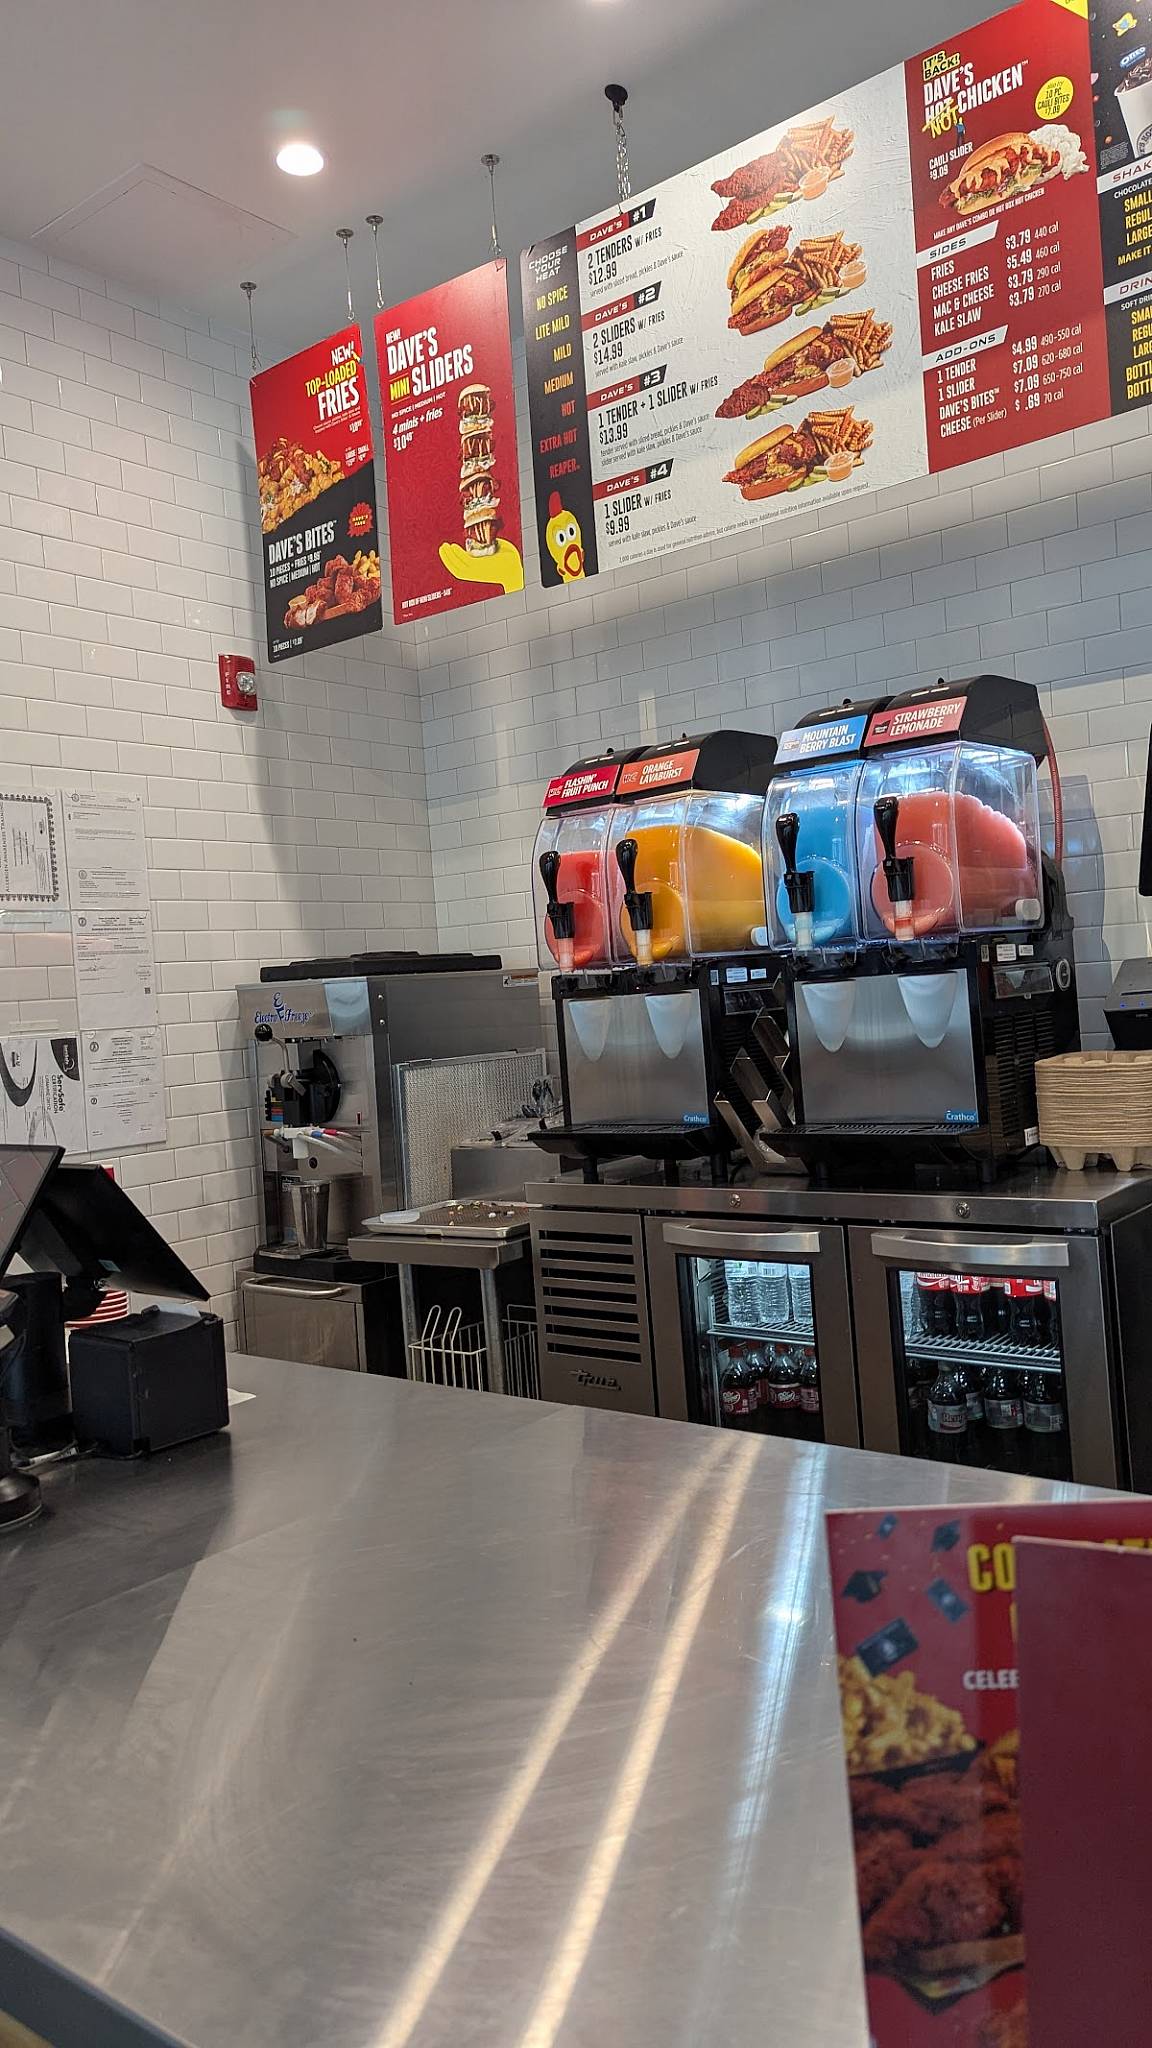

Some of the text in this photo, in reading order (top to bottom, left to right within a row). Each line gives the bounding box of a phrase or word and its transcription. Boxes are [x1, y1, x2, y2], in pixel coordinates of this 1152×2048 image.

[924, 52, 945, 69] IT'S
[925, 55, 960, 80] BACK!
[923, 62, 974, 106] DAVE'S
[929, 142, 973, 170] CAULI SLIDER
[929, 164, 949, 181] $9.09
[590, 205, 648, 242] DAVE'S #1
[529, 245, 568, 270] CHOOSE
[587, 253, 594, 269] 2
[594, 235, 633, 266] TENDERS
[645, 227, 663, 244] FRIES
[929, 237, 967, 259] SIDES
[931, 220, 1059, 282] FRIES $3.79 440 cal
[1117, 244, 1152, 266] MAKE IT
[534, 257, 562, 276] YOUR
[535, 265, 561, 284] HEAT
[588, 261, 617, 286] $12.99
[931, 241, 1060, 300] CHEESE FRIES $5.49 460 cal
[536, 284, 569, 312] NO SPICE
[933, 261, 1061, 320] MAC & CHEESE $3.79 290 cal
[595, 287, 656, 322] DAVE'S #2
[934, 280, 1062, 337] KALE SLAW $3.79 270 cal
[1121, 299, 1138, 311] SOFT
[386, 327, 402, 345] NEW!
[535, 314, 570, 341] LITE MILD
[592, 332, 599, 349] 2
[601, 316, 636, 346] SLIDERS
[648, 310, 665, 327] FRIES
[331, 341, 355, 367] NEW!
[387, 325, 439, 376] DAVE'S
[554, 342, 572, 363] MILD
[593, 341, 623, 366] $14.99
[935, 333, 996, 363] ADD-ONS
[937, 322, 1082, 384] 1 TENDER $4.99 490-550 cal
[305, 360, 358, 398] TOP-LOADED
[390, 344, 474, 402] MINI SLIDERS
[543, 370, 575, 395] MEDIUM
[938, 342, 1083, 402] 1 SLIDER $7.09 620-680 cal
[318, 377, 360, 421] FRIES
[600, 370, 661, 402] DAVE'S #3
[938, 400, 969, 421] DAVE'S
[1014, 373, 1040, 394] $7.09
[1042, 365, 1072, 386] 650-750
[1072, 363, 1083, 377] cal
[561, 399, 576, 417] HOT
[598, 412, 605, 429] 1
[606, 400, 639, 426] TENDER
[648, 393, 655, 411] 1
[657, 381, 688, 408] SLIDER
[701, 375, 719, 391] FRIES
[940, 416, 972, 438] CHEESE
[972, 414, 986, 429] (Per
[987, 407, 1007, 424] Slider)
[1043, 391, 1053, 404] 70
[1053, 388, 1064, 401] cal
[392, 407, 444, 436] 4 minis + fries
[599, 422, 628, 446] $13.99
[539, 427, 578, 455] EXTRA HOT
[606, 463, 668, 493] DAVE'S #4
[604, 503, 611, 519] 1
[612, 493, 643, 517] SLIDER
[655, 489, 672, 504] FRIES
[605, 515, 630, 536] $9.99
[268, 533, 304, 565] DAVE'S
[889, 717, 944, 737] LEMONADE
[893, 702, 961, 725] STRAWBERRY
[799, 737, 828, 754] BERRY
[828, 733, 856, 748] BLAST
[802, 725, 848, 743] MOUNTAIN
[564, 773, 597, 789] FLASHIN'
[639, 767, 684, 786] LAVABURST
[641, 760, 674, 775] ORANGE
[561, 785, 584, 799] FRUIT
[583, 780, 609, 795] PUNCH
[945, 1111, 976, 1122] Crathco
